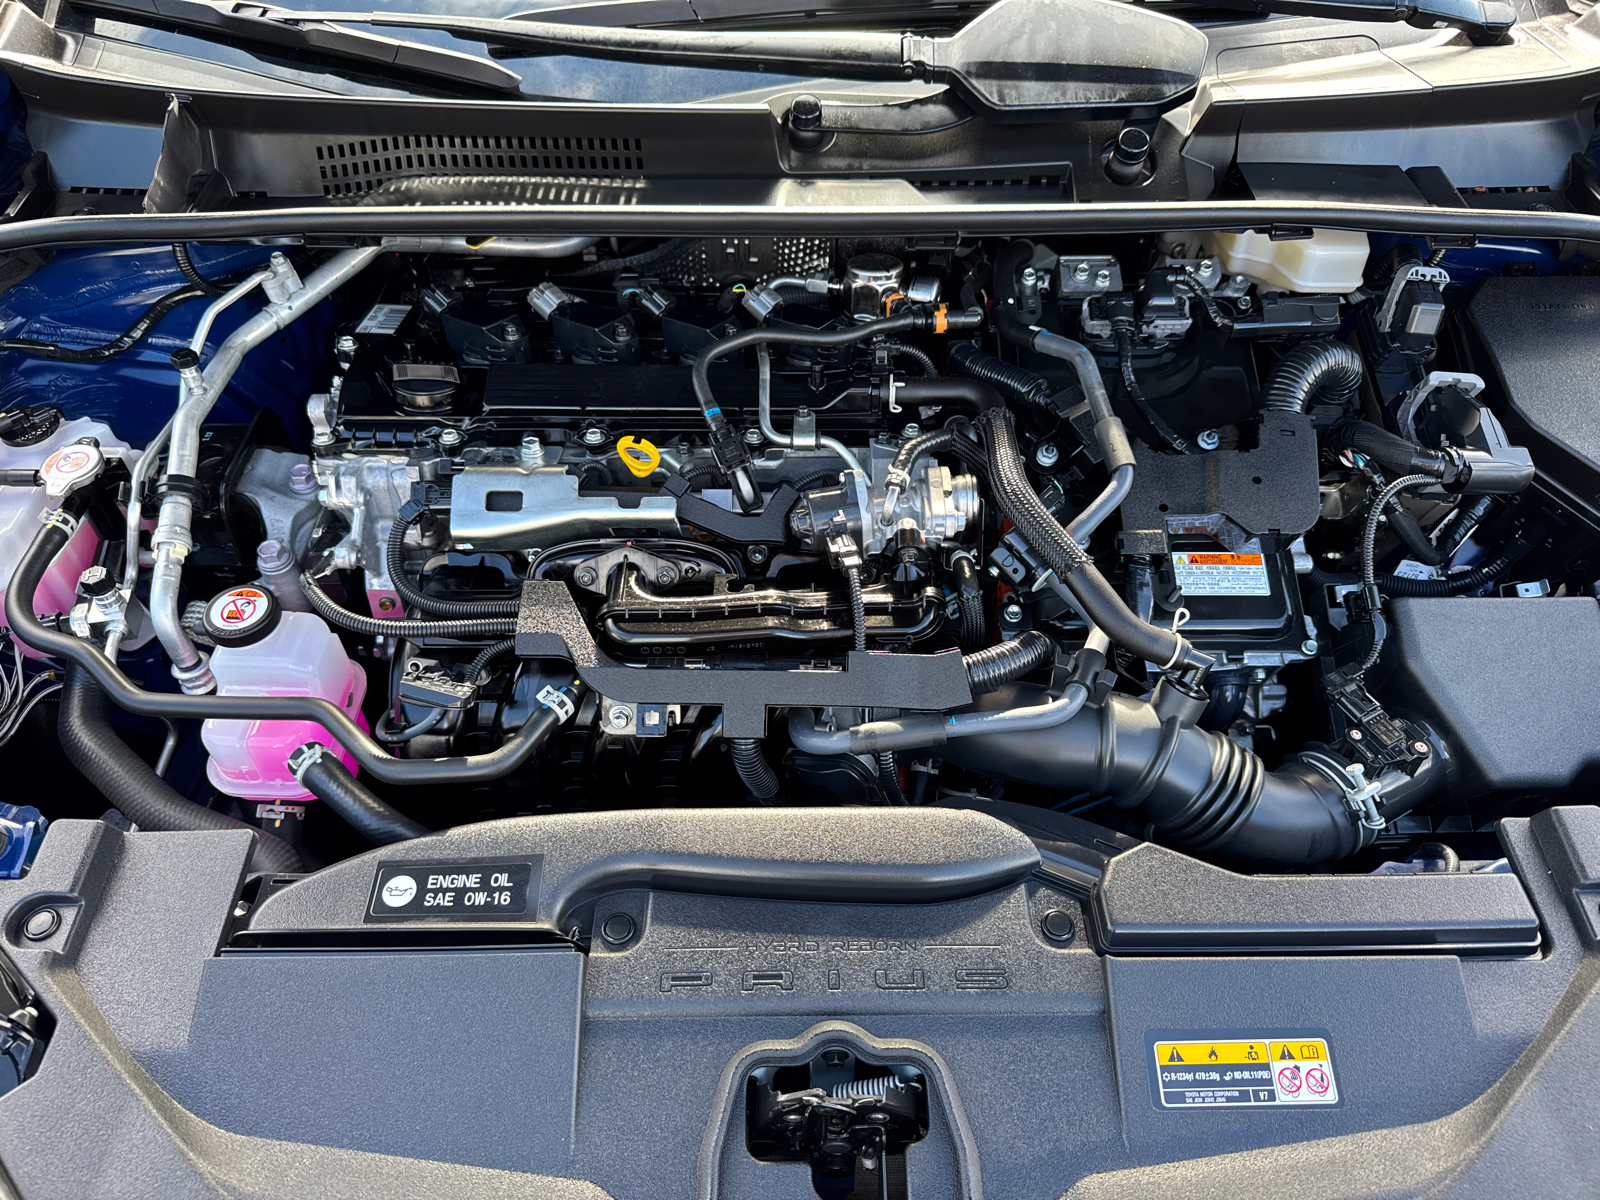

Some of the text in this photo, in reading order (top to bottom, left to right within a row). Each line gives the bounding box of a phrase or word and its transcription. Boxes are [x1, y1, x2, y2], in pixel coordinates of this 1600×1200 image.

[426, 873, 514, 889] ENGINE OIL
[423, 891, 511, 907] SAE 0W-16
[744, 940, 918, 953] HYBRID REBORN
[659, 968, 1009, 993] PRIUS
